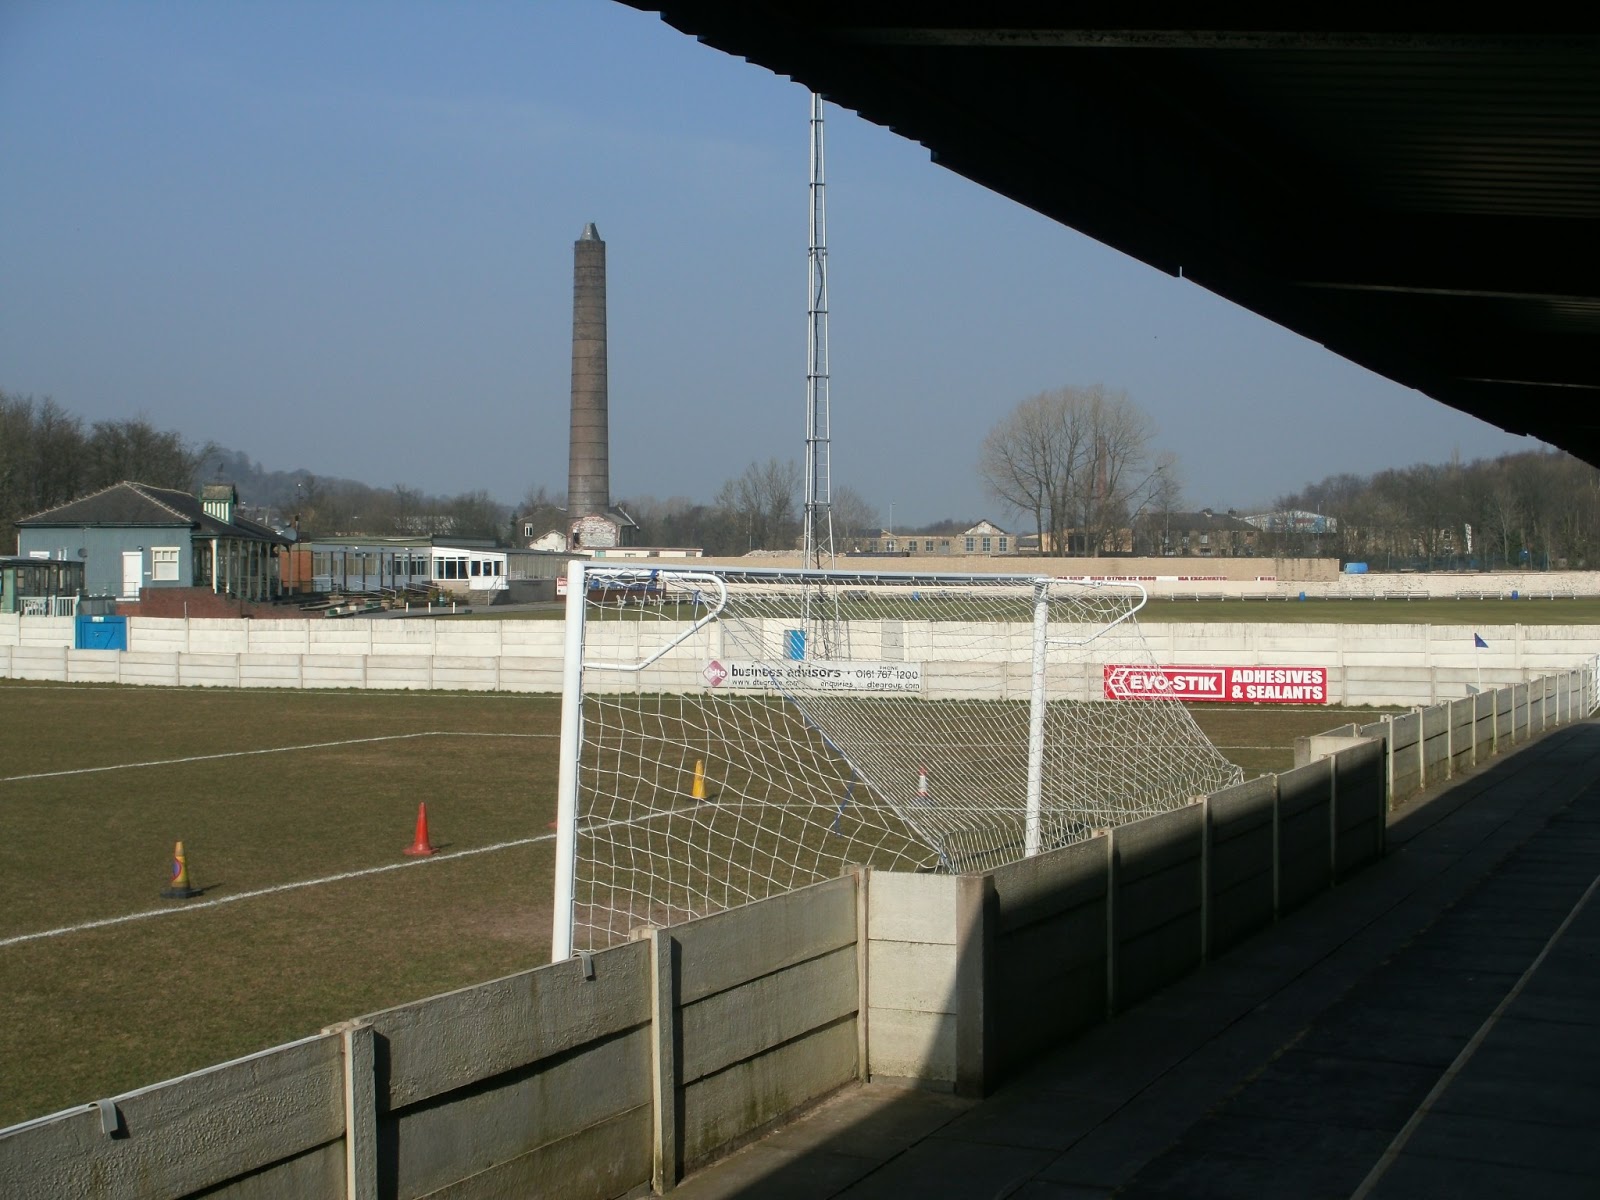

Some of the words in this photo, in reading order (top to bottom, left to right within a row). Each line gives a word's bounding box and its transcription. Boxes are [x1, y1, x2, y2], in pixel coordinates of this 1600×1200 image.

[731, 664, 783, 678] business
[787, 664, 841, 678] advisors
[896, 670, 918, 680] 1200
[1231, 670, 1323, 684] ADHESIVES
[1130, 675, 1217, 691] EVO-STIK
[1231, 685, 1243, 699] &
[1246, 685, 1323, 699] SEALANTS
